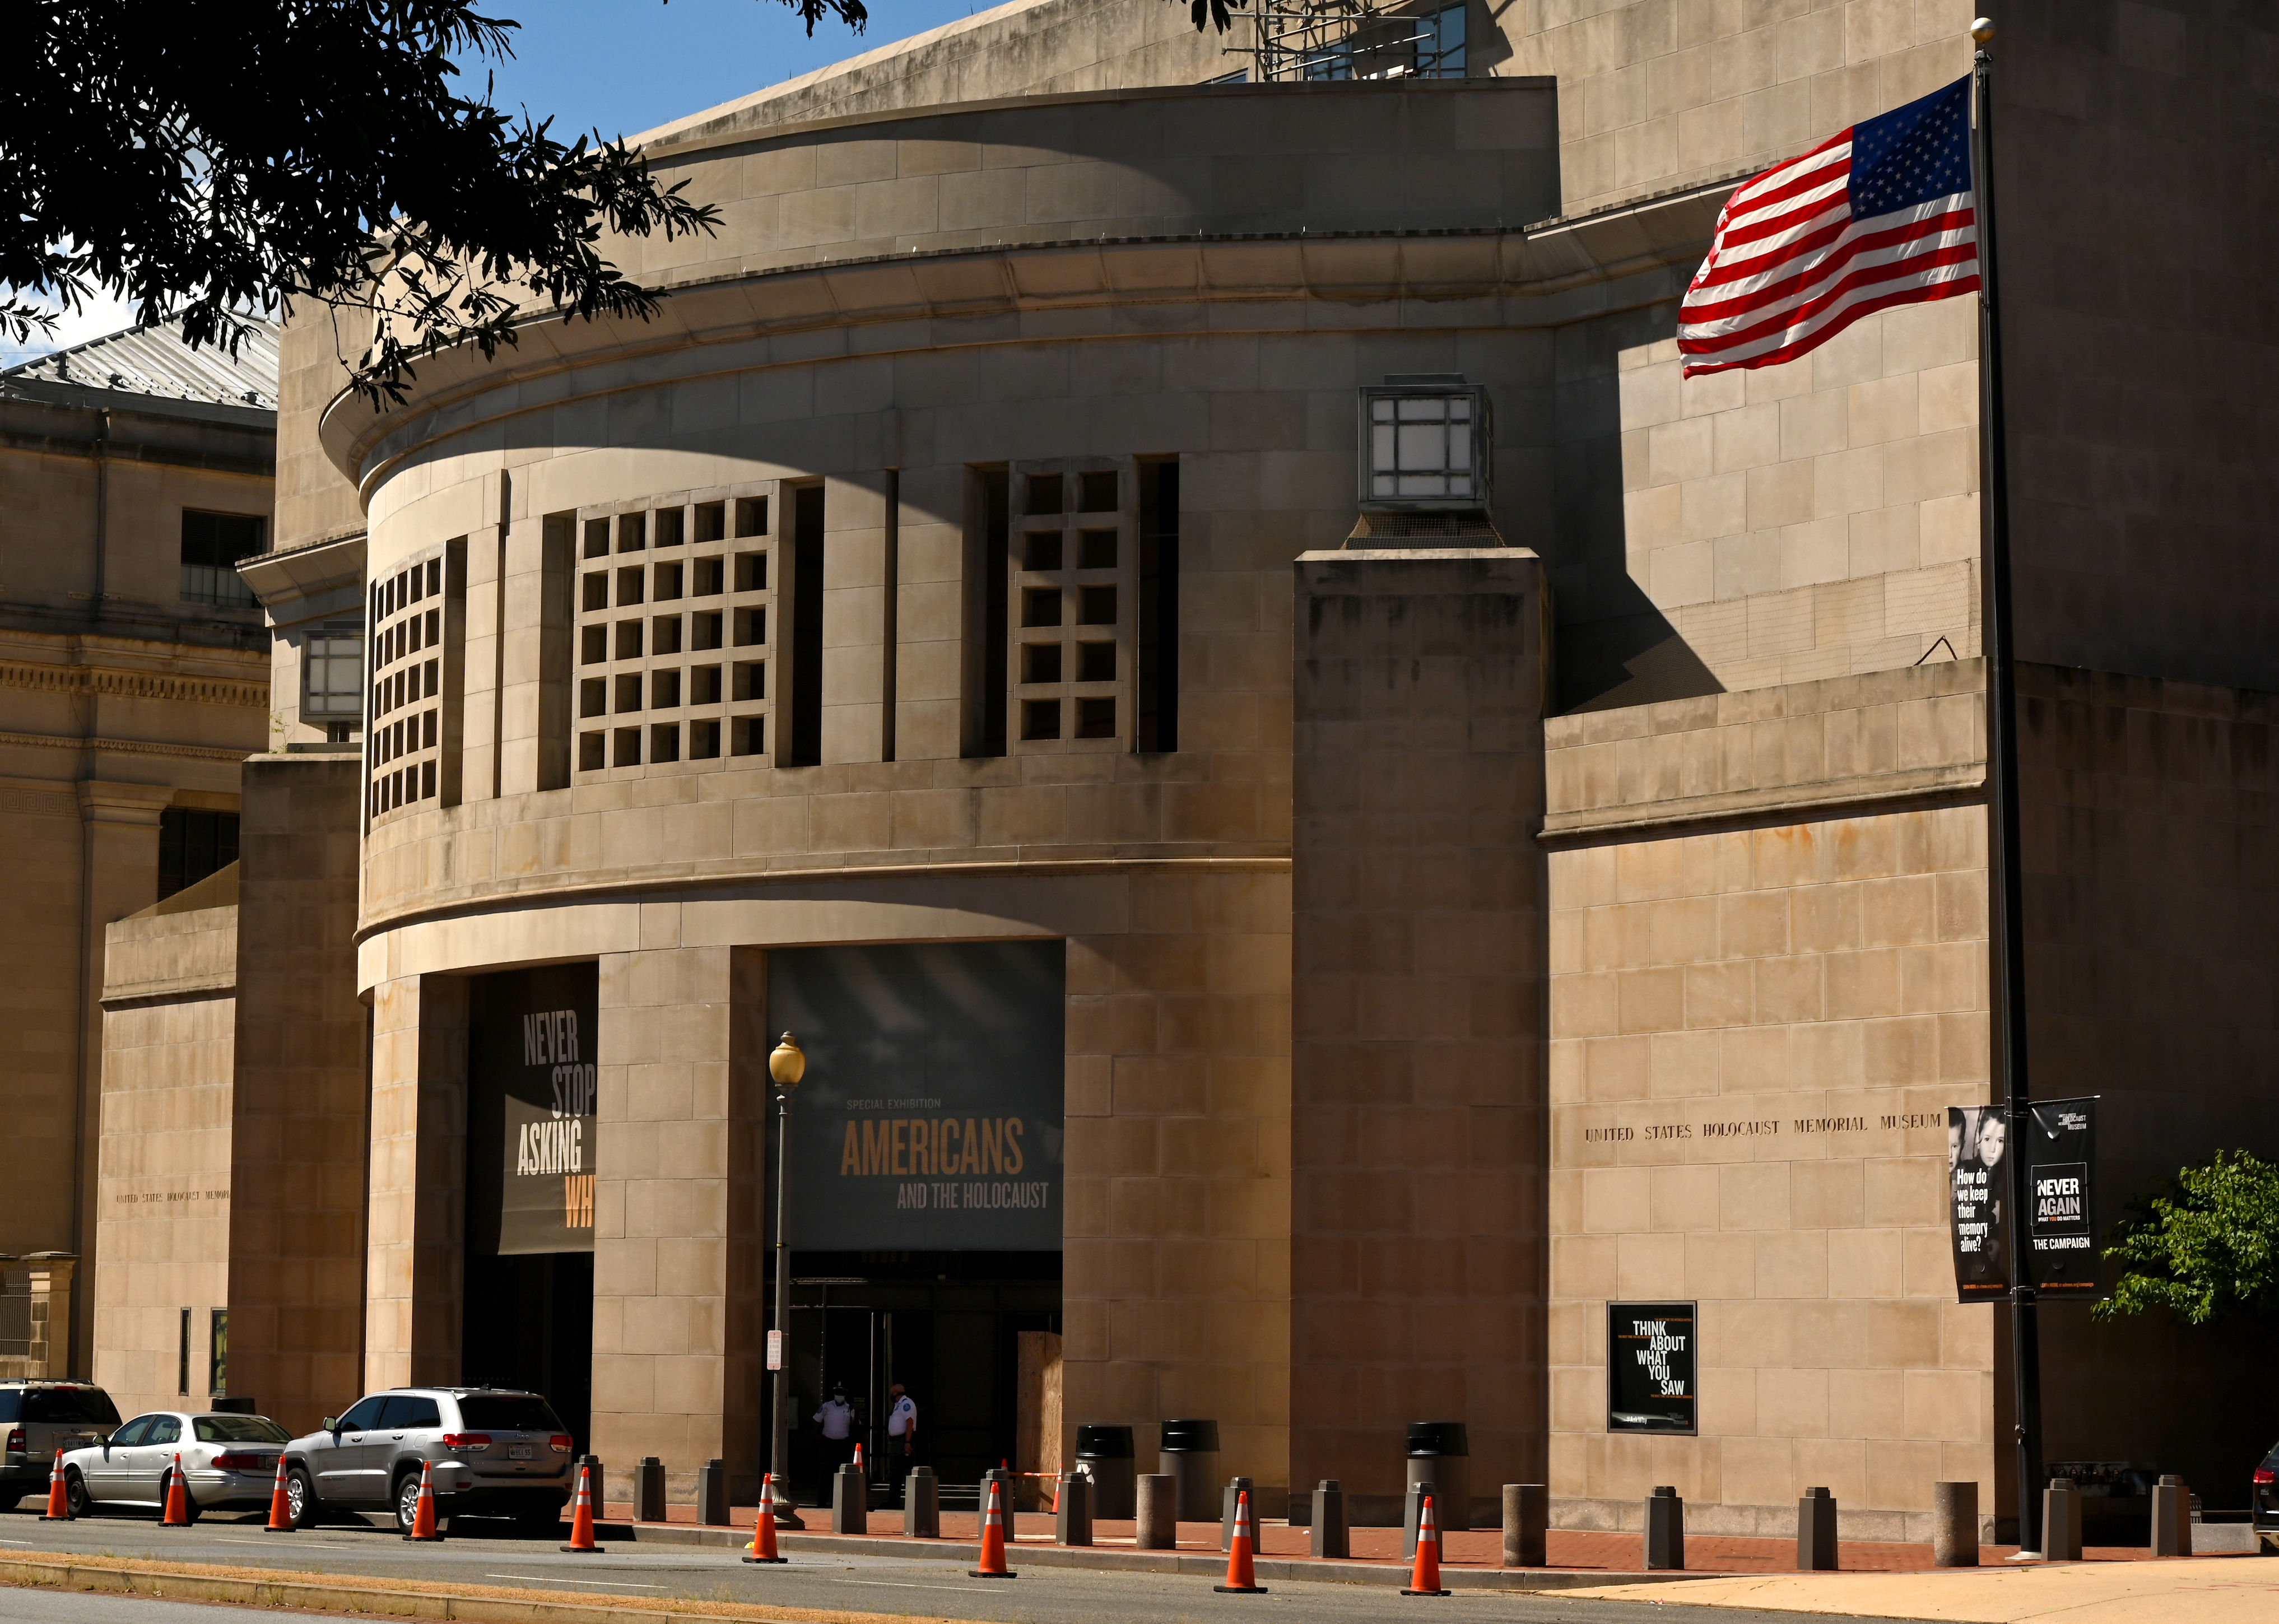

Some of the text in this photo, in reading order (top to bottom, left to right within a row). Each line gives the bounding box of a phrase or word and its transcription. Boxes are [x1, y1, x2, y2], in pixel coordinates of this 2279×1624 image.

[524, 1009, 579, 1066] NEVER
[552, 1064, 596, 1119] STOP
[847, 1099, 941, 1110] SPECIAL EXHIBITION
[1585, 1114, 1941, 1143] UNITED STATES HOLOCAUST MEMORIAL MUSEUM
[517, 1119, 582, 1175] ASKING
[840, 1117, 1024, 1176] AMERICANS
[1957, 1168, 1987, 1185] How do
[897, 1181, 1049, 1208] AND THE HOLOCAUST
[1957, 1185, 1988, 1204] we keep
[2037, 1178, 2080, 1196] NEVER
[117, 1190, 231, 1204] UNITED STATES HOLOCAUST MEMORI
[1957, 1203, 1976, 1218] their
[2038, 1197, 2080, 1216] AGAIN
[1959, 1222, 1988, 1237] memory
[1960, 1235, 1982, 1252] alive?
[2033, 1237, 2090, 1250] THE CAMPAIGN
[1632, 1320, 1666, 1336] THINK
[1650, 1336, 1686, 1351] ABOUT
[1636, 1350, 1667, 1365] WHAT
[1648, 1365, 1669, 1380] YOU
[1661, 1380, 1685, 1395] SAW
[1626, 1416, 1648, 1425] #AskWhy
